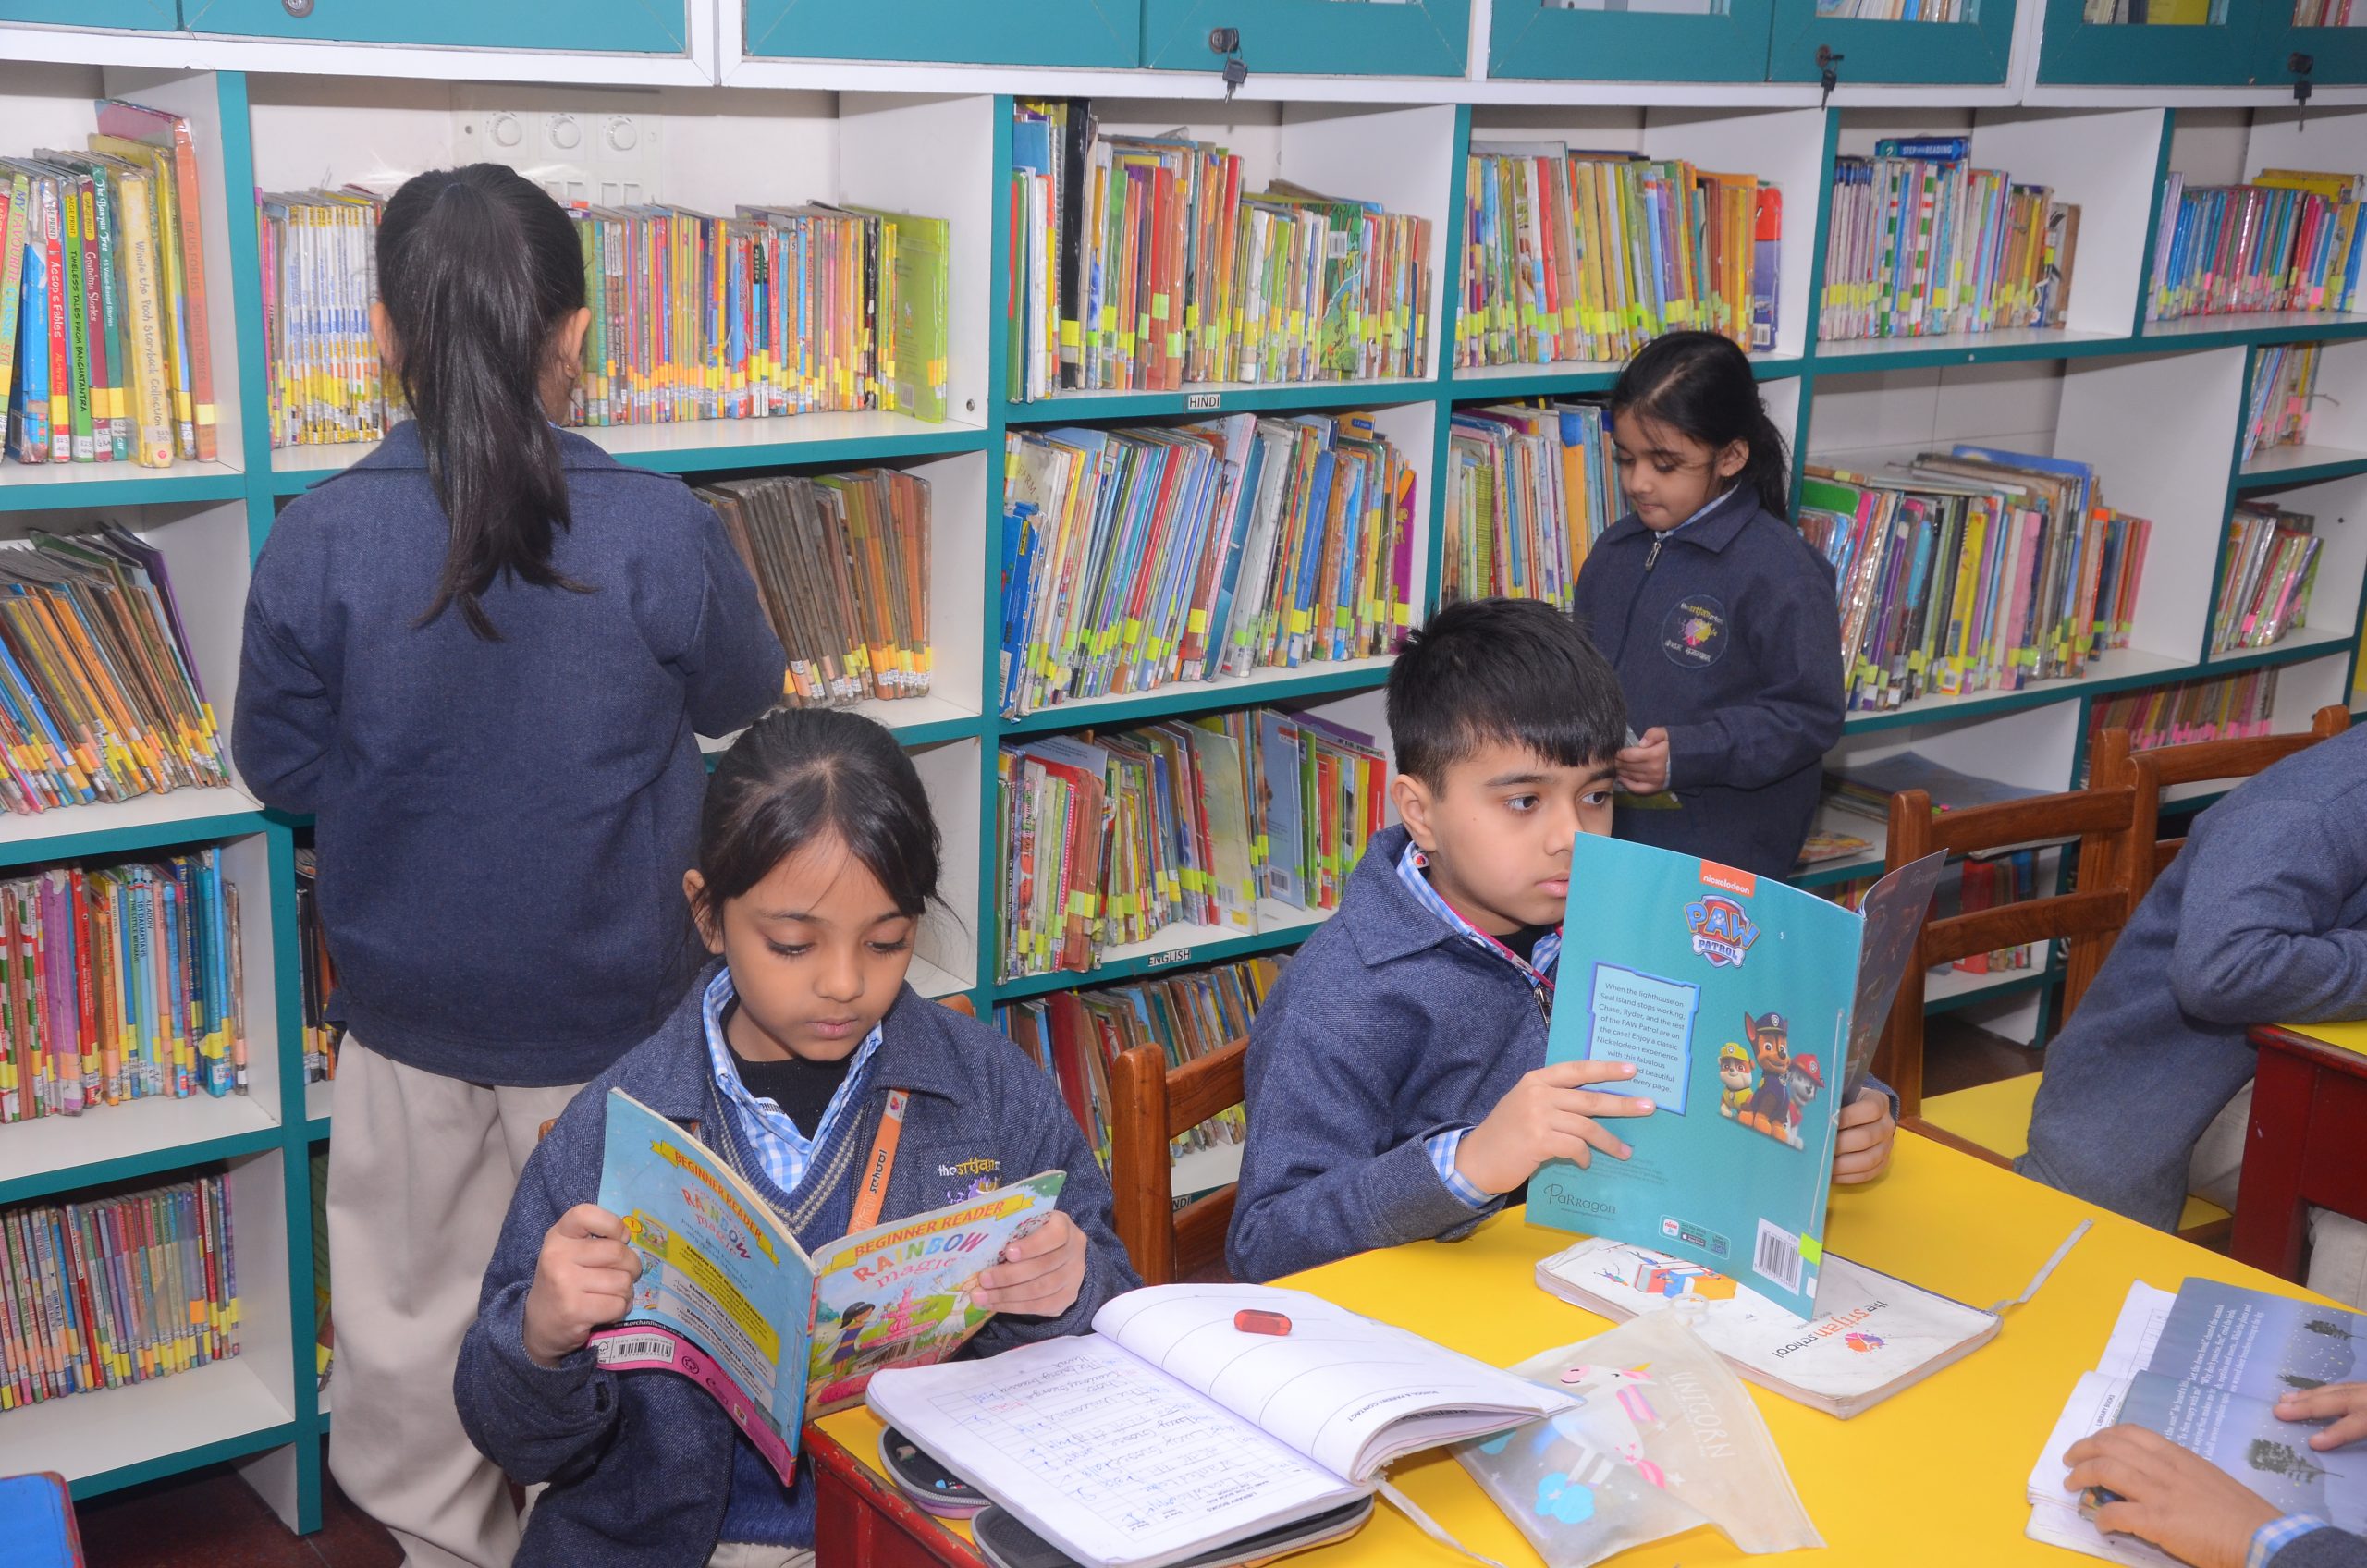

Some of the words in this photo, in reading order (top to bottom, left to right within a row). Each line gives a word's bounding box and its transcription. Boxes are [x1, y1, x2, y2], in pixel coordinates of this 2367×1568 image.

[15, 190, 26, 211] MY
[95, 179, 105, 196] The
[68, 219, 77, 235] PRINT
[95, 197, 106, 231] Banyan
[7, 212, 24, 281] FAVOURITE
[99, 232, 109, 251] Tree
[70, 251, 80, 292] TIMELESS
[85, 251, 96, 291] Grandma
[135, 241, 145, 276] Winnie
[49, 262, 60, 301] Aesop's
[139, 278, 148, 294] the
[73, 294, 81, 318] TALES
[141, 299, 153, 321] Pooh
[52, 303, 62, 338] Fables
[143, 325, 158, 374] Storybook
[76, 346, 86, 411] PANCHATANTRA
[151, 379, 162, 431] Collection
[1190, 397, 1220, 408] HINDI
[1018, 464, 1036, 496] FARM
[1703, 874, 1750, 895] nickelodeon
[138, 915, 146, 957] DALMATIANS
[1684, 901, 1760, 950] PAW
[1148, 949, 1190, 965] ENGLISH
[1699, 939, 1738, 960] PATROL
[1600, 993, 1615, 1001] Seal
[1616, 996, 1636, 1006] Island
[1637, 1001, 1655, 1011] stops
[1657, 1007, 1686, 1020] working,
[1605, 983, 1625, 993] When
[1638, 989, 1674, 1006] lighthouse
[1599, 1004, 1622, 1014] Chase,
[1624, 1009, 1644, 1020] Ryder,
[1646, 1014, 1659, 1023] and
[1660, 1018, 1671, 1026] the
[1609, 1017, 1621, 1025] the
[1622, 1020, 1638, 1029] PAW
[1639, 1024, 1659, 1035] Patrol
[1597, 1036, 1640, 1051] Nickelodeon
[1642, 1047, 1678, 1062] experience
[1617, 1029, 1631, 1039] case!
[1632, 1033, 1650, 1045] Enjoy
[1657, 1039, 1678, 1050] classic
[1607, 1050, 1623, 1059] with
[1624, 1053, 1636, 1061] this
[1637, 1057, 1665, 1069] fabulous
[1633, 1078, 1651, 1088] every
[1652, 1084, 1671, 1093] page.
[1646, 1069, 1674, 1083] beautiful
[869, 1149, 888, 1194] school
[675, 1151, 725, 1196] BEGINNER
[725, 1192, 762, 1240] READER
[681, 1188, 752, 1260] RAINBOW
[854, 1220, 938, 1258] BEGINNER
[941, 1200, 1006, 1230] READER
[852, 1232, 989, 1283] RAINBOW
[877, 1256, 957, 1288] magic
[1865, 1299, 1888, 1315] the
[1813, 1305, 1870, 1339] srijan
[1772, 1332, 1818, 1360] school
[1346, 1402, 1378, 1422] CONTACT
[1668, 1371, 1736, 1460] UNICORN
[2095, 1407, 2108, 1427] LIBRARY
